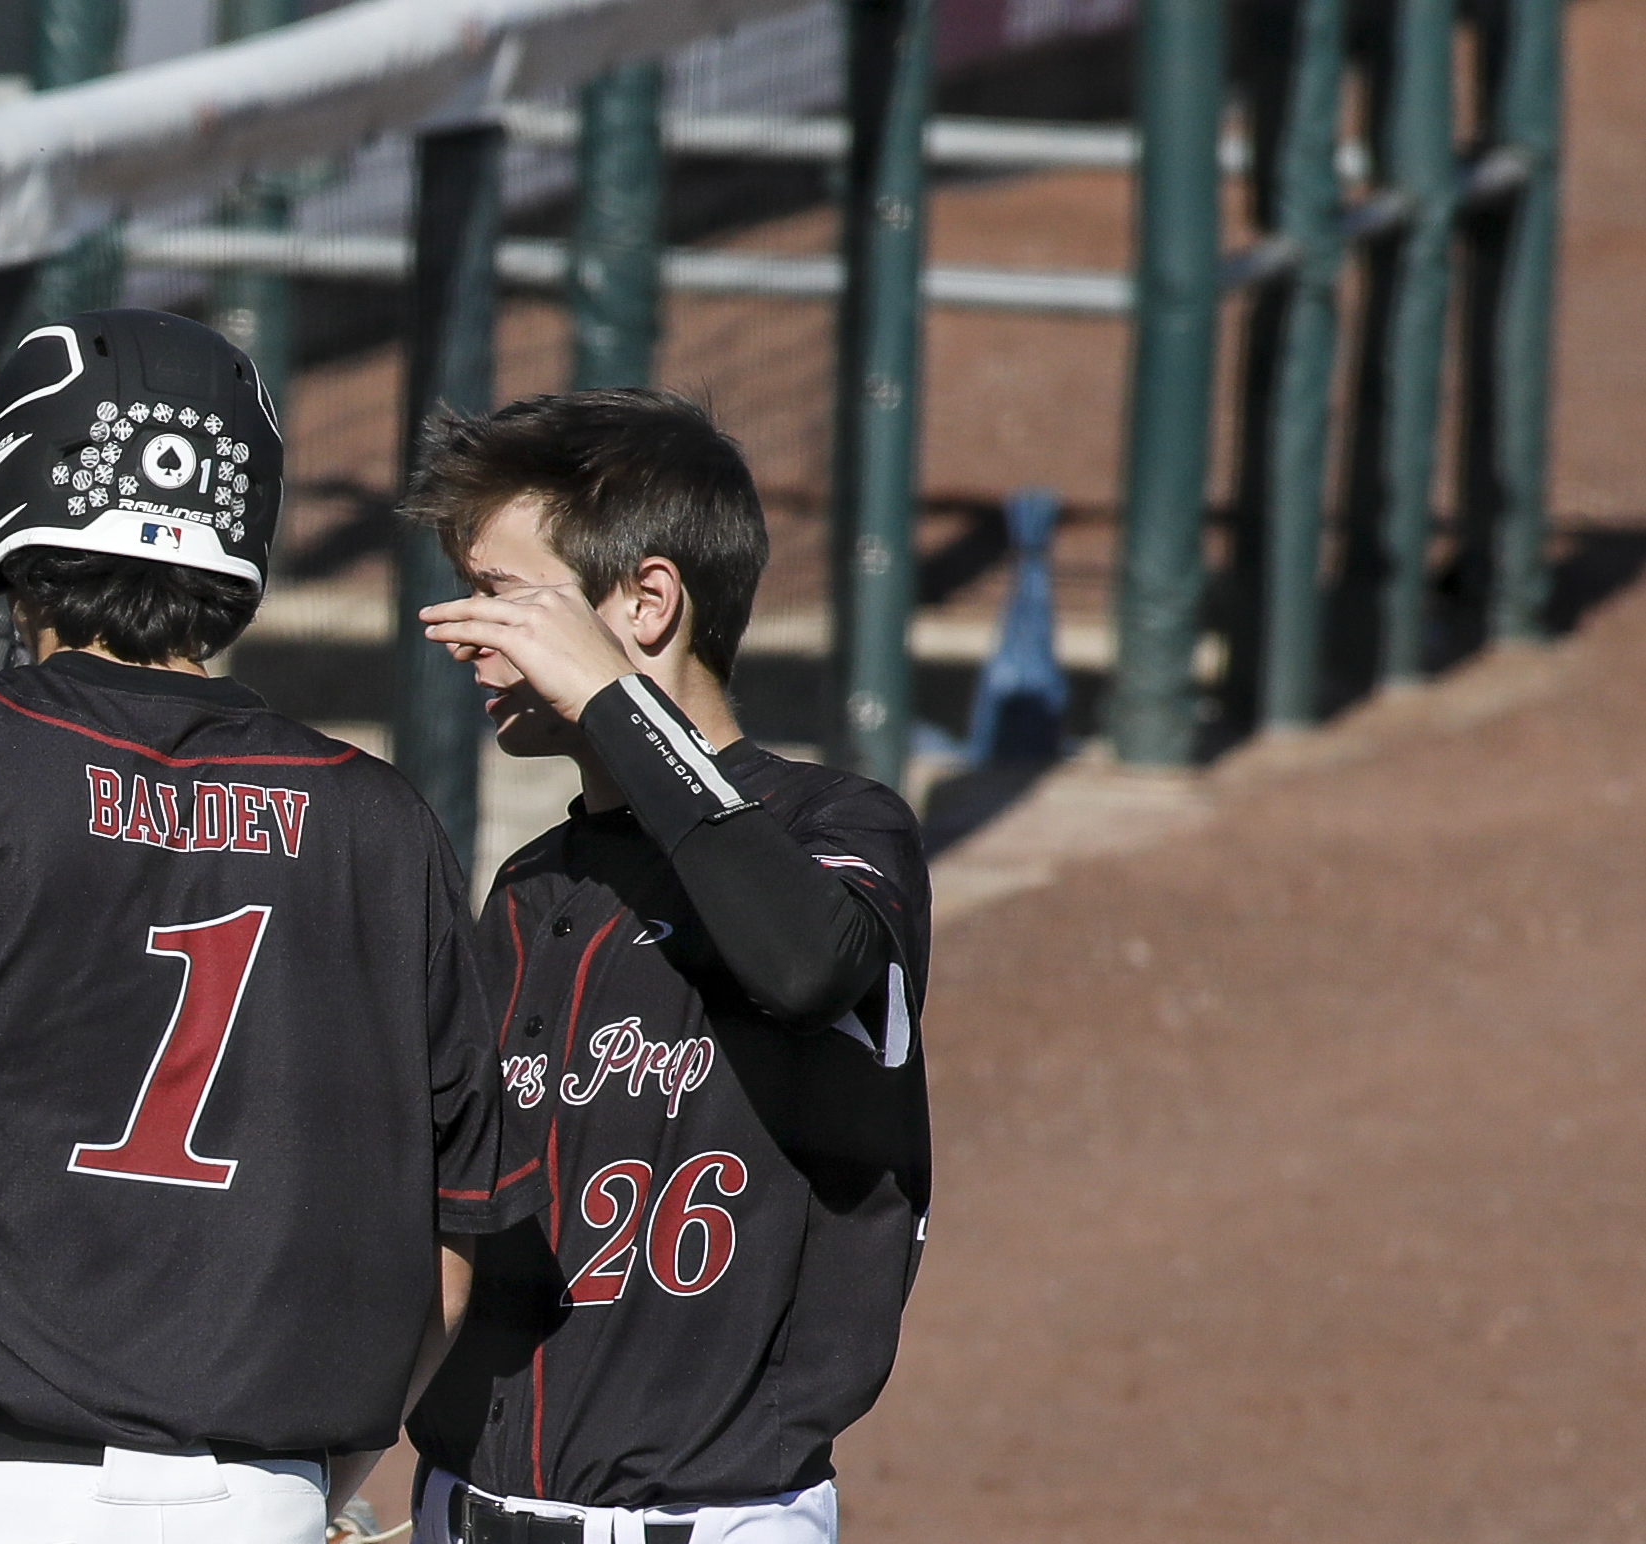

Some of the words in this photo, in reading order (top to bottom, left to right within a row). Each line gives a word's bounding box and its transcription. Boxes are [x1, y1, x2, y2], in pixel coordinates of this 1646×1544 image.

[118, 498, 214, 525] RAWLINGS
[198, 458, 212, 494] 1
[85, 764, 310, 859] BALDEV
[66, 904, 273, 1190] 1
[560, 1150, 748, 1307] 26
